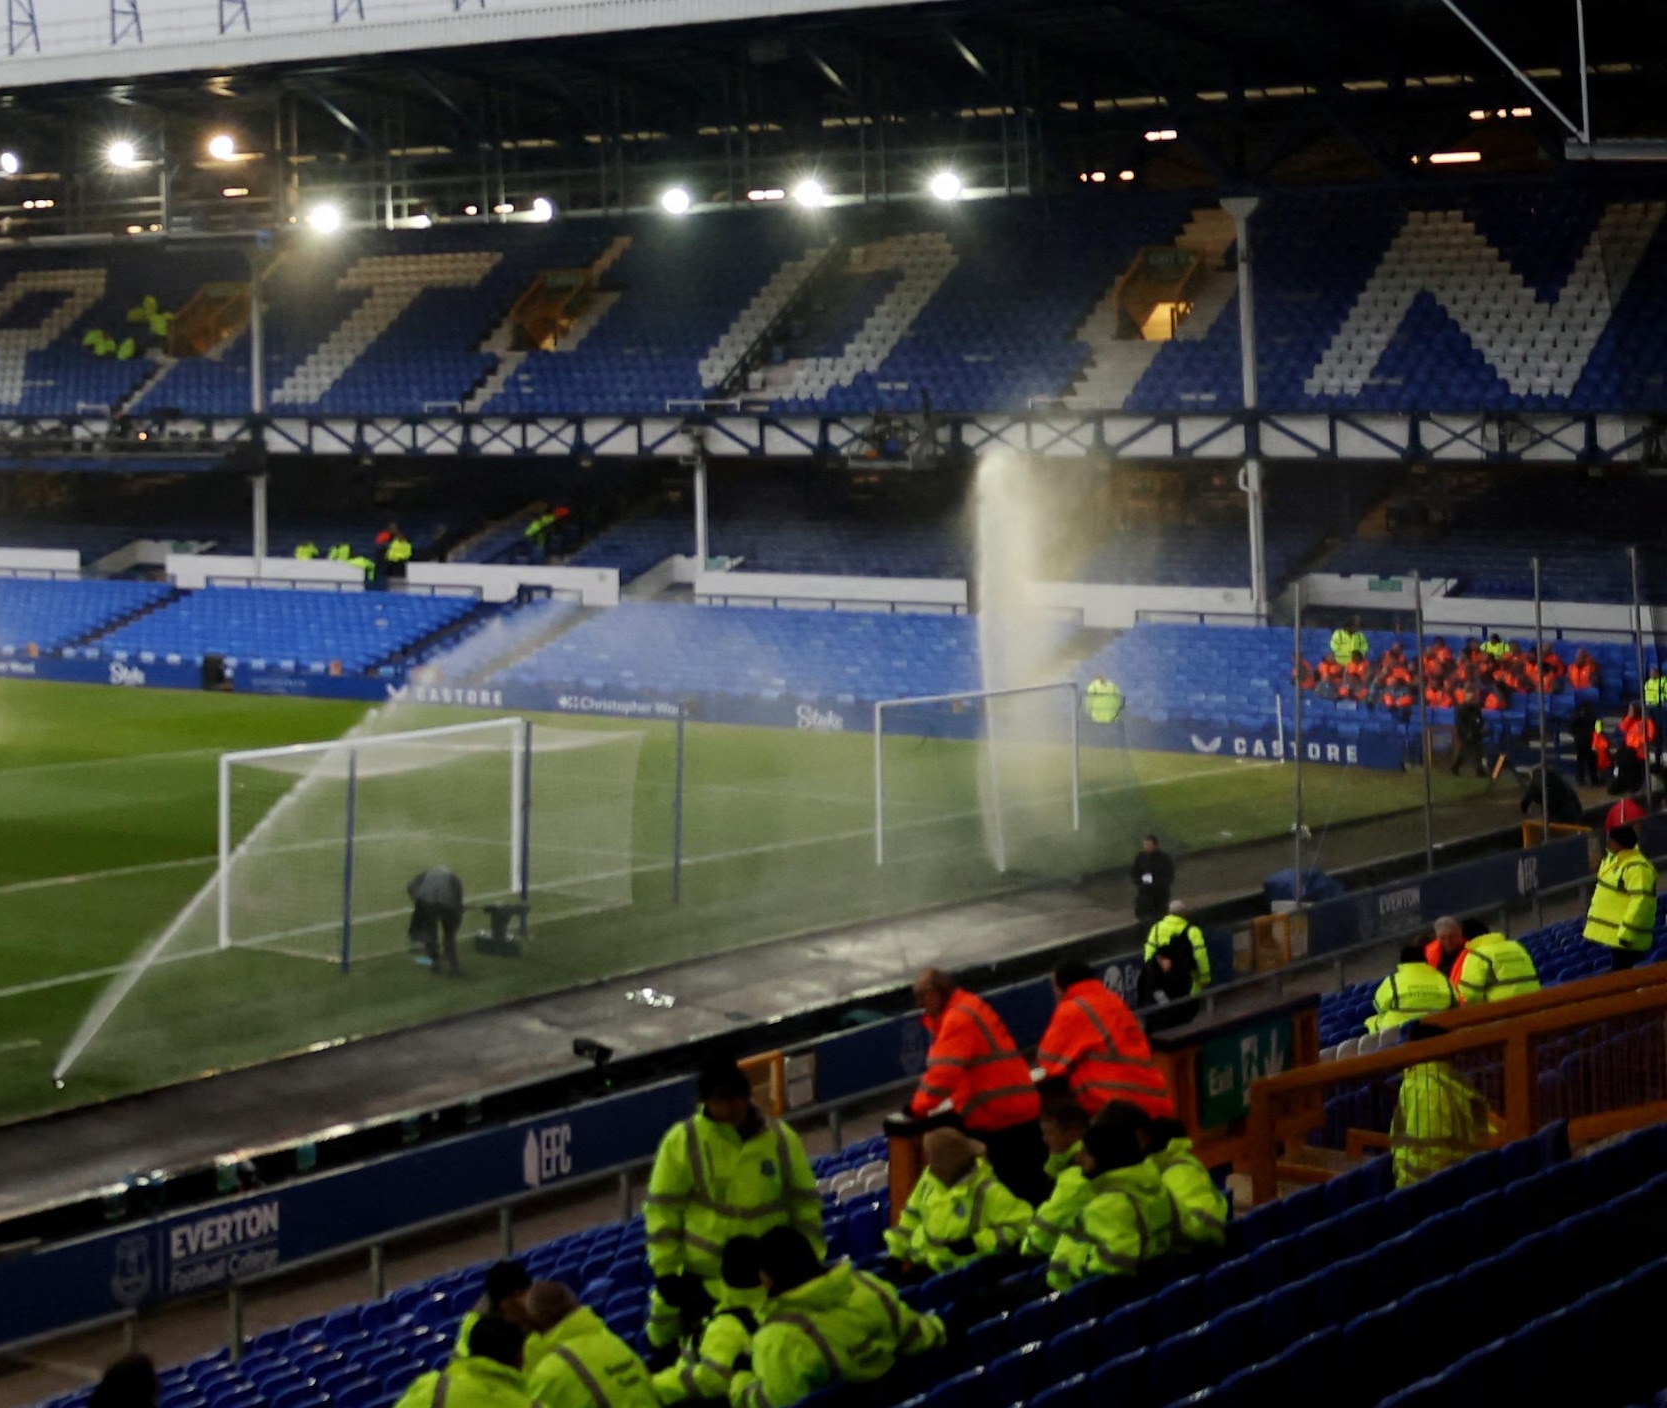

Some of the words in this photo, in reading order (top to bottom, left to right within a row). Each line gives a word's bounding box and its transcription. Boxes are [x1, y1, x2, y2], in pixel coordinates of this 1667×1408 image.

[581, 695, 653, 716] Christopher
[1234, 736, 1359, 764] CASTORE
[541, 1124, 573, 1178] EFC
[170, 1201, 280, 1260] EVERTON
